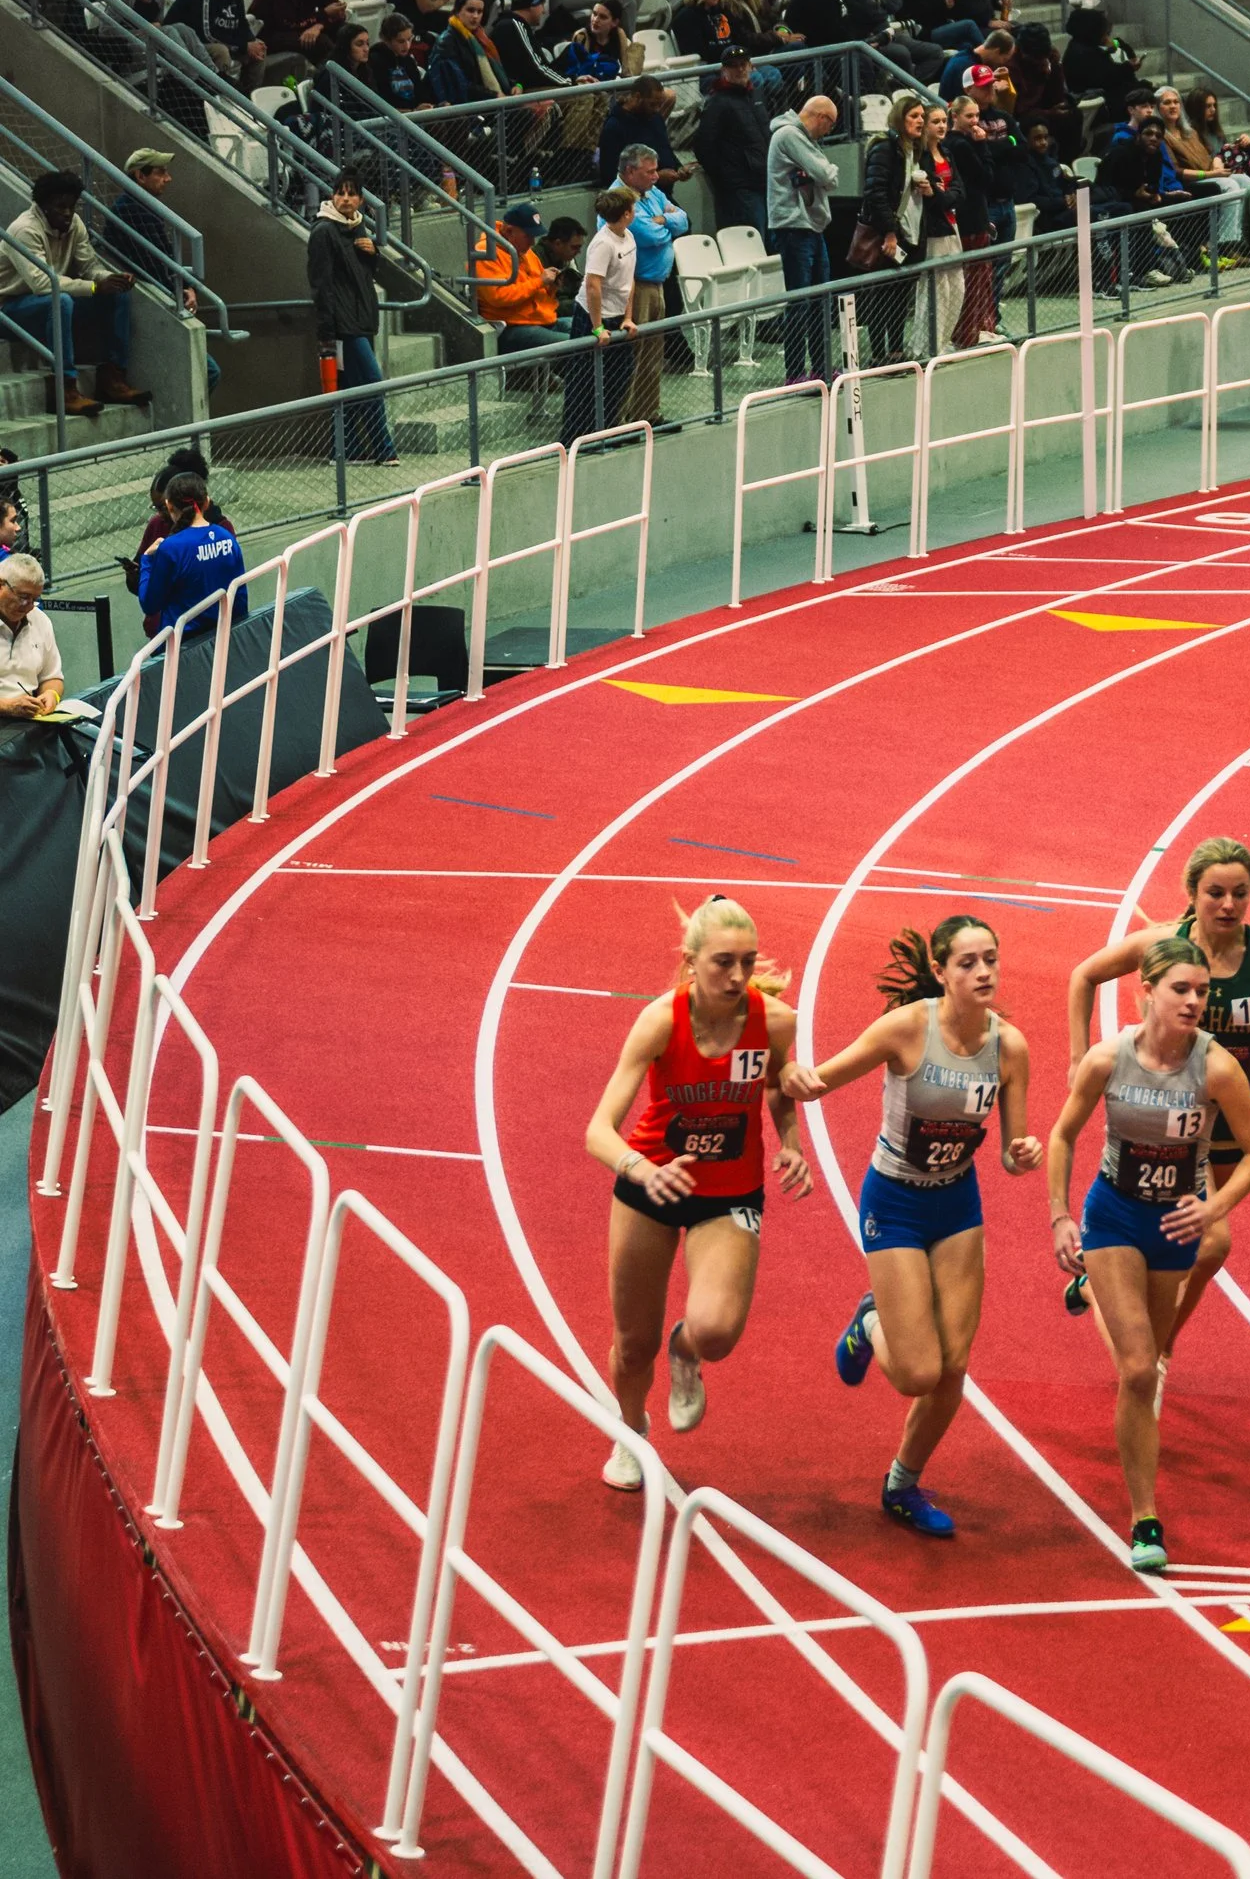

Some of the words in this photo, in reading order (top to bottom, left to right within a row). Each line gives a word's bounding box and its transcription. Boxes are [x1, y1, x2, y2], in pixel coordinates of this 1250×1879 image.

[847, 317, 863, 422] FINSH
[196, 538, 233, 562] JUMPER
[44, 601, 71, 610] TRACK
[739, 1051, 765, 1080] 15
[975, 1085, 997, 1112] 14
[1119, 1085, 1196, 1109] CUMBERLAND
[1177, 1111, 1202, 1137] 13
[684, 1133, 725, 1153] 652
[927, 1141, 965, 1165] 228
[1138, 1163, 1178, 1188] 240
[739, 1207, 760, 1234] 15
